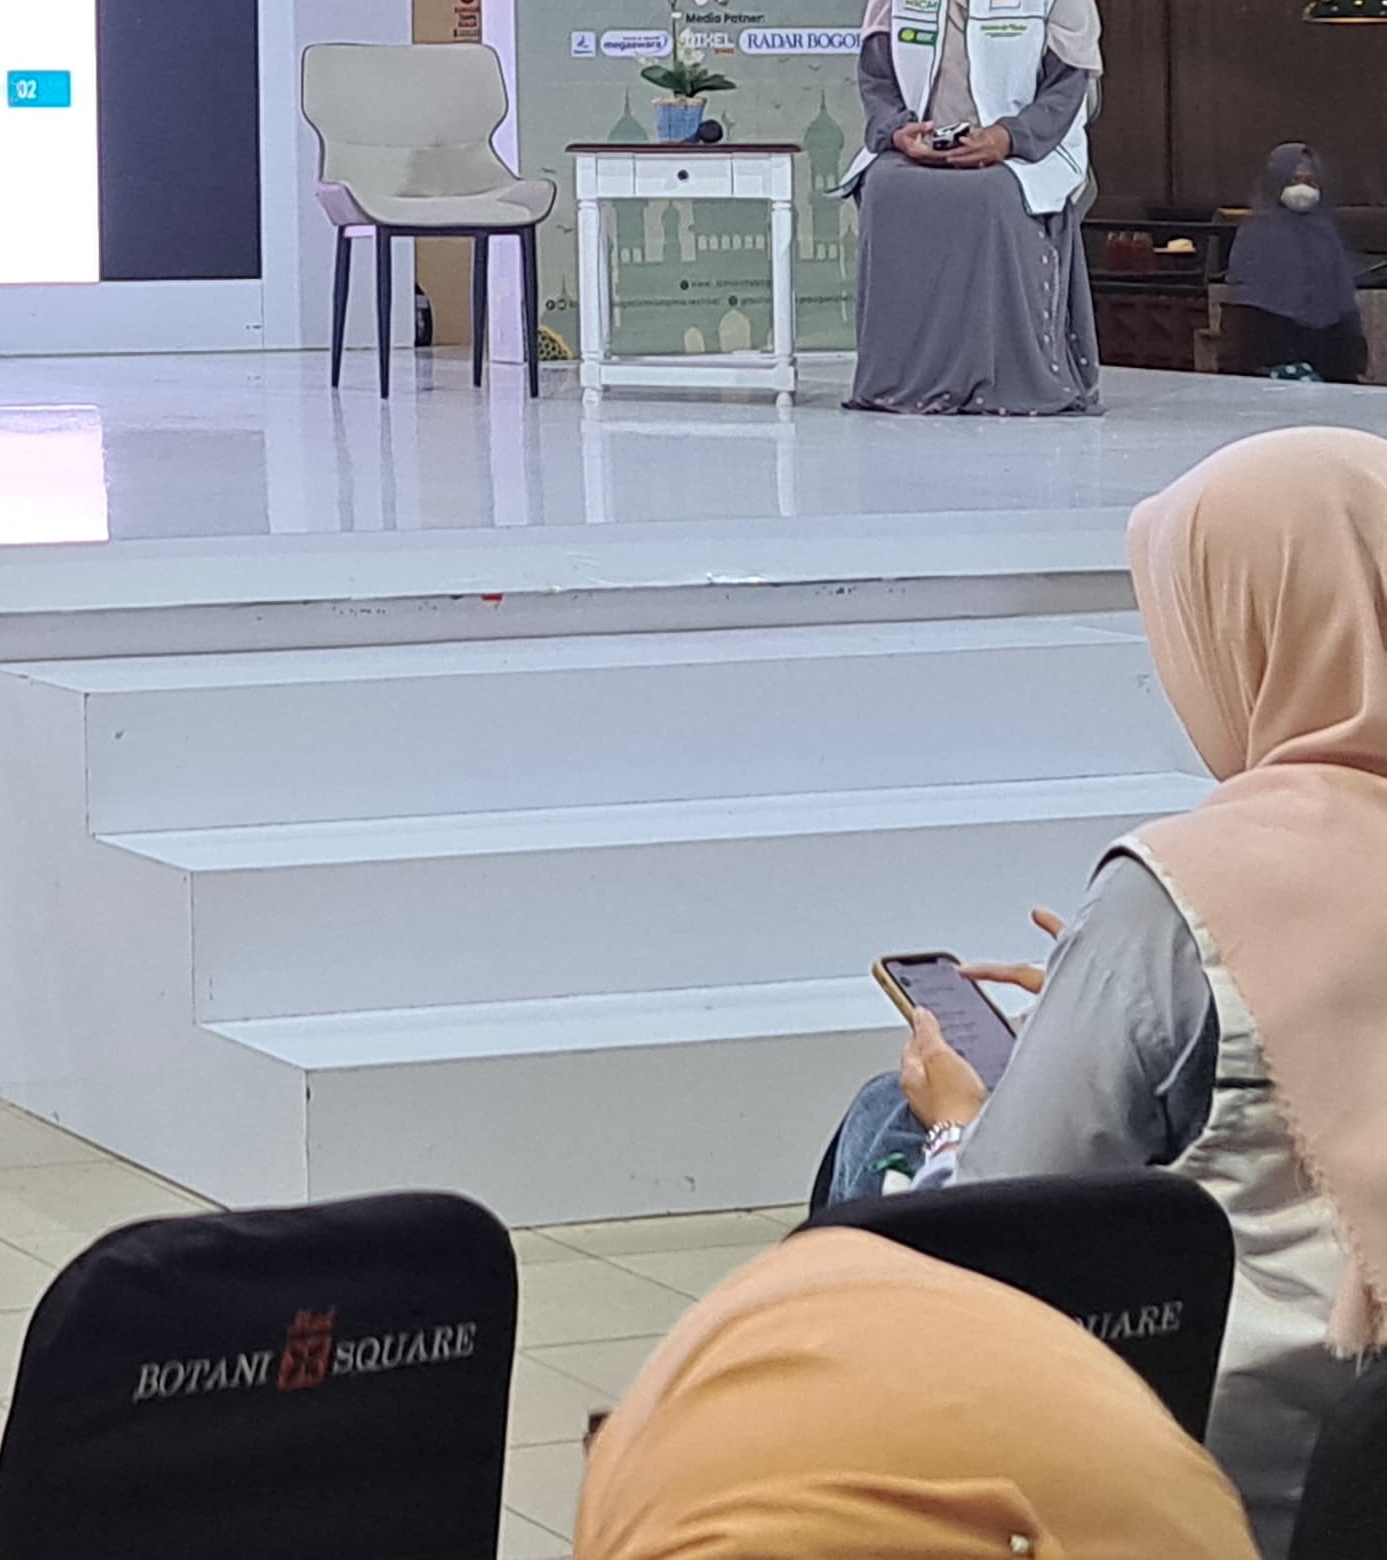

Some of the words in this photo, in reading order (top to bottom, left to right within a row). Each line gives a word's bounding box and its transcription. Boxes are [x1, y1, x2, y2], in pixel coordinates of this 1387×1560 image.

[685, 12, 720, 25] Media
[747, 32, 804, 49] RADAR
[133, 1351, 274, 1404] BOTANI
[332, 1322, 476, 1377] SQUARE
